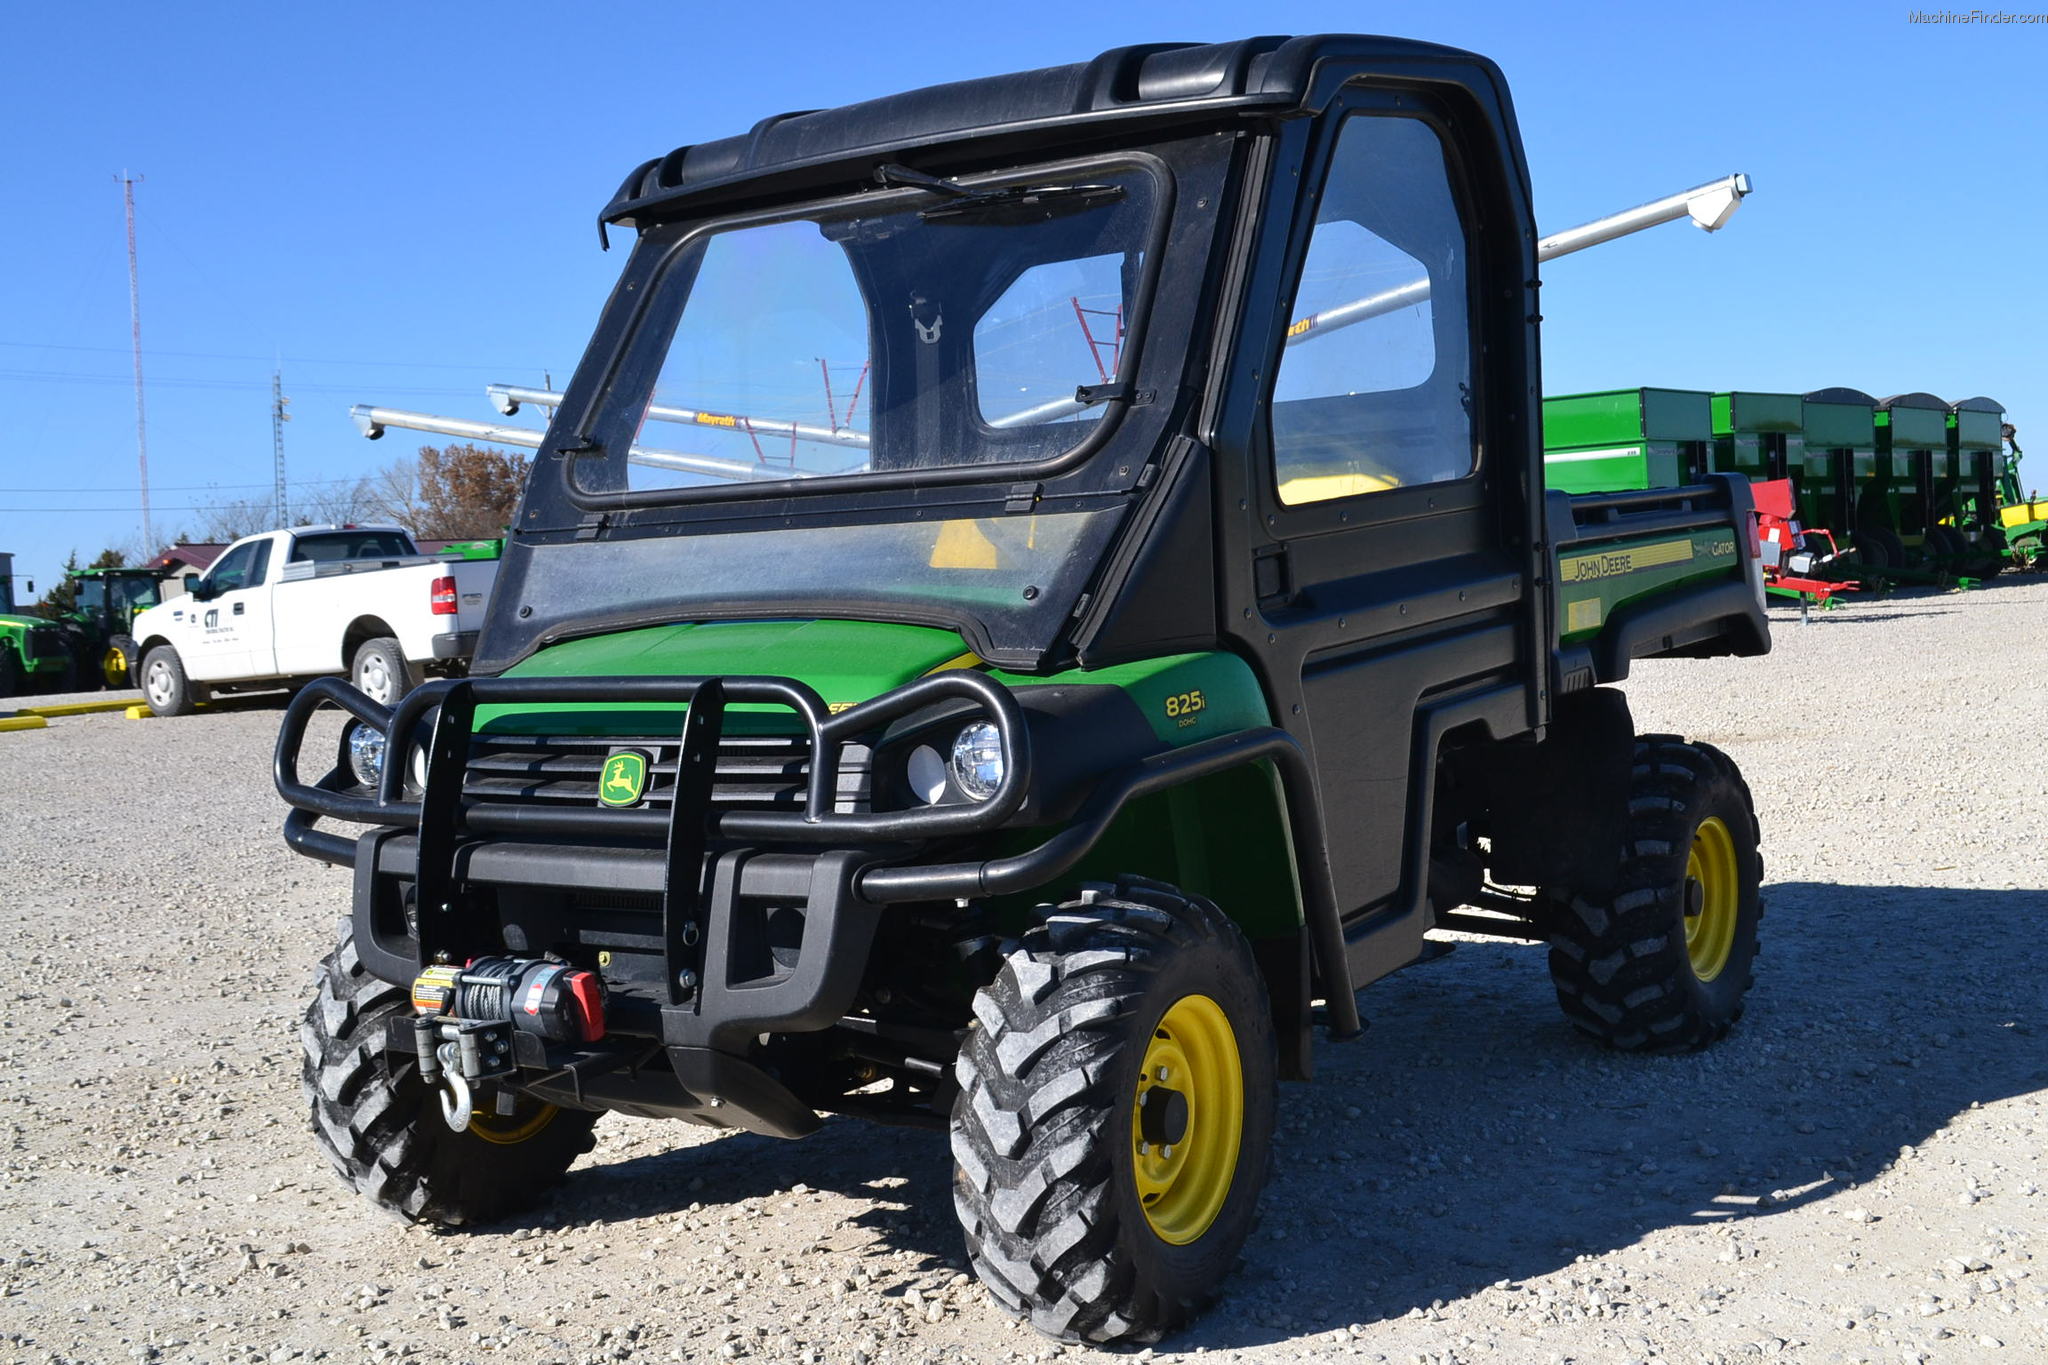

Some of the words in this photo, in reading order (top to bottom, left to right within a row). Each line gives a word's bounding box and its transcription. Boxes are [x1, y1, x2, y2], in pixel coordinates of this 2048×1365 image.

[697, 411, 736, 427] Mayrath
[204, 608, 219, 628] CTI
[1165, 690, 1205, 717] 825i
